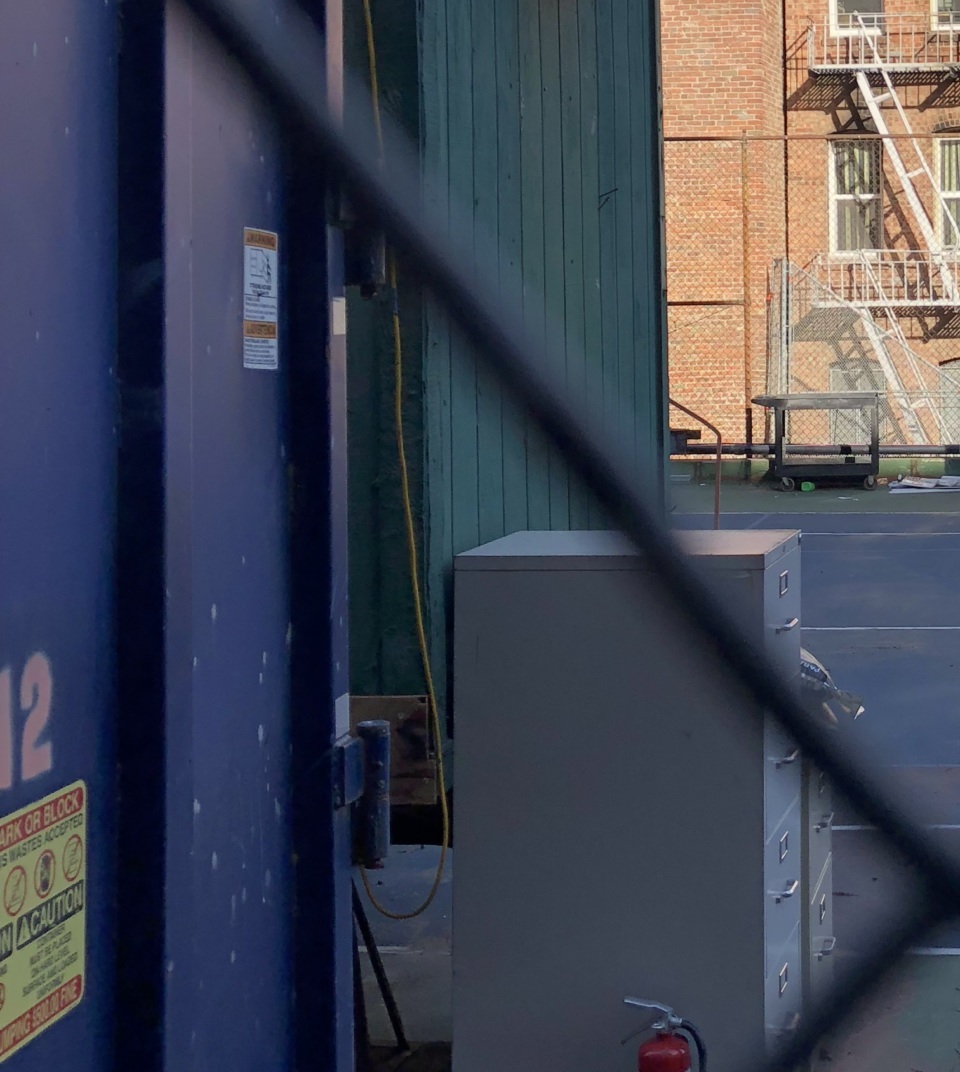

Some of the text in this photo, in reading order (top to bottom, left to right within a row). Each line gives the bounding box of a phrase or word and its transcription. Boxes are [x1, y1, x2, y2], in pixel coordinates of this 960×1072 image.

[9, 835, 42, 864] WASTES
[45, 813, 83, 842] ACCEPTED
[24, 811, 41, 835] OR
[43, 791, 80, 826] BLOCK
[30, 883, 82, 936] CAUTION
